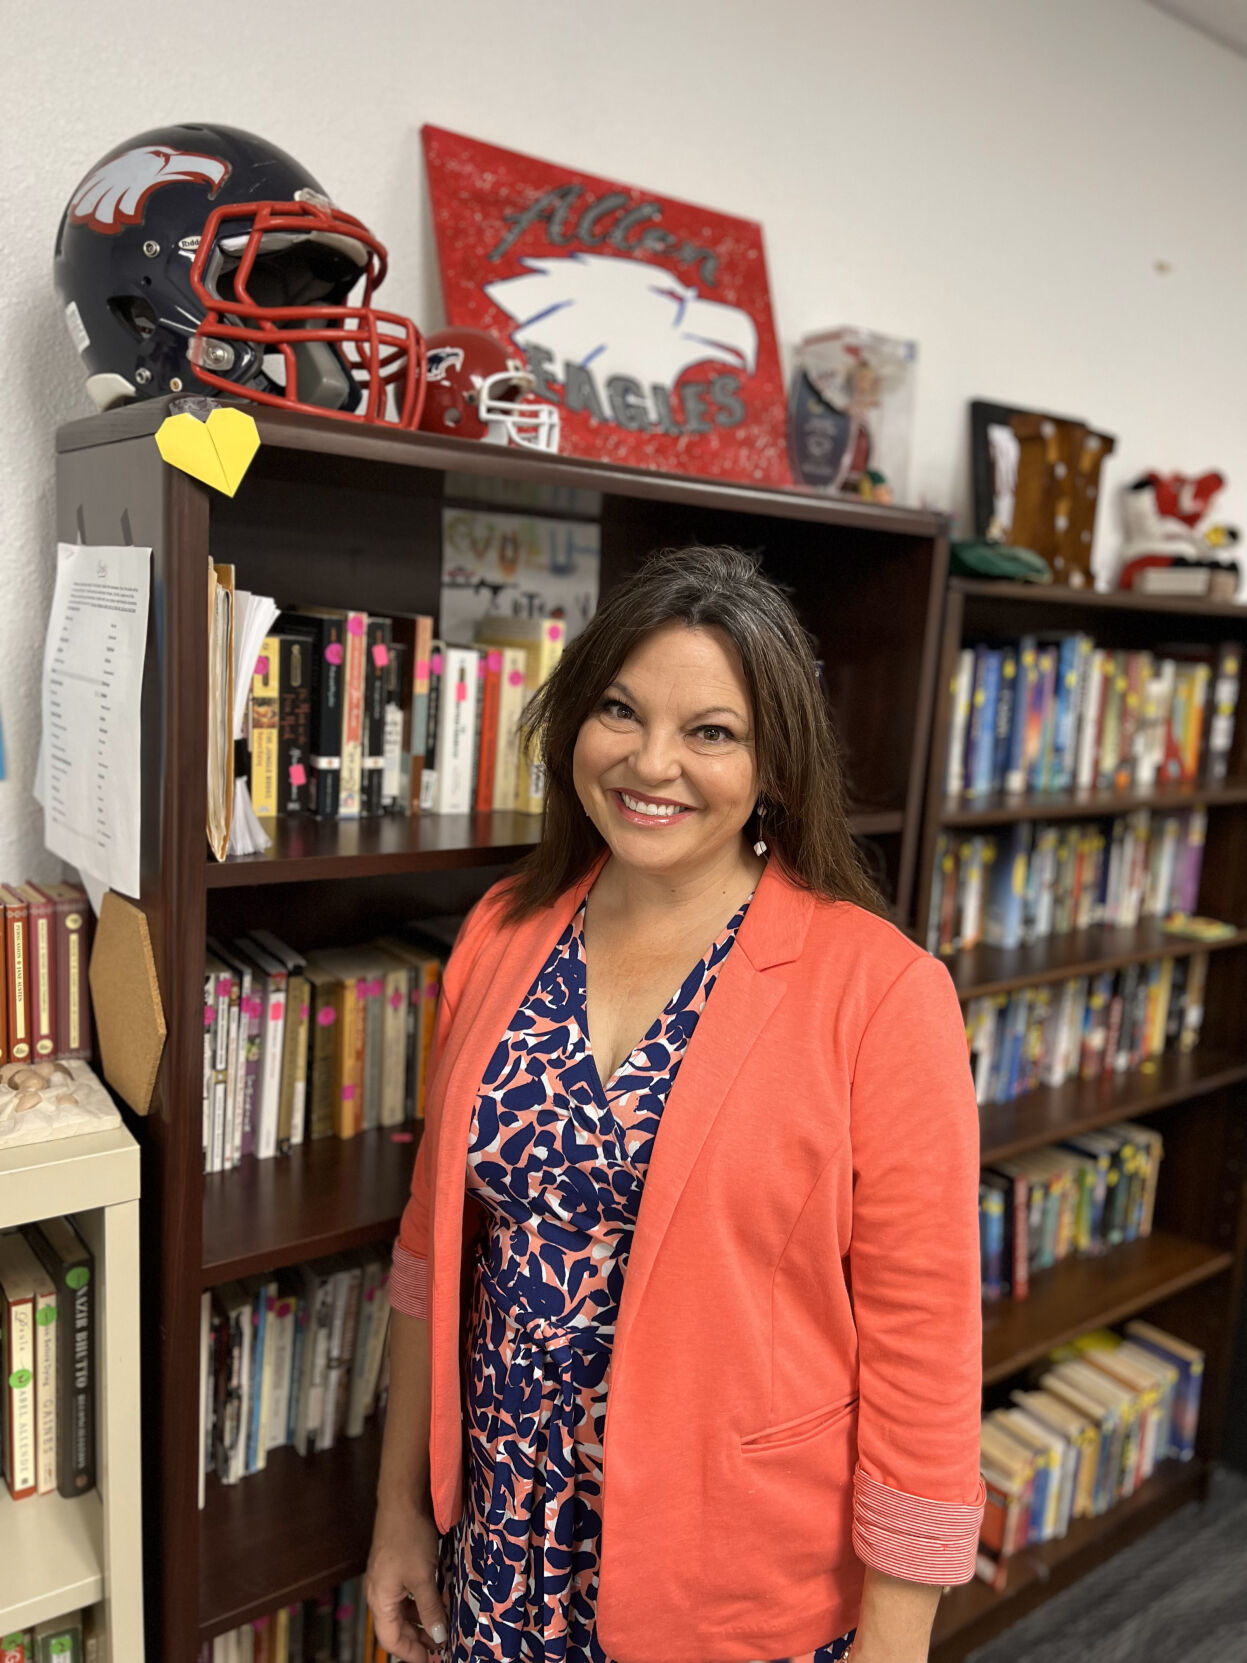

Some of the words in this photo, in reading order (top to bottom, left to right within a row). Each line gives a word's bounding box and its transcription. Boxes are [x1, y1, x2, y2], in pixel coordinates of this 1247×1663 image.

[489, 183, 720, 288] Allen
[522, 337, 746, 435] EAGLES
[42, 1364, 52, 1387] Dying
[43, 1338, 53, 1363] Before
[74, 1331, 89, 1389] BHUTTO
[18, 1421, 28, 1473] ALLENDE
[42, 1399, 54, 1455] GAINES
